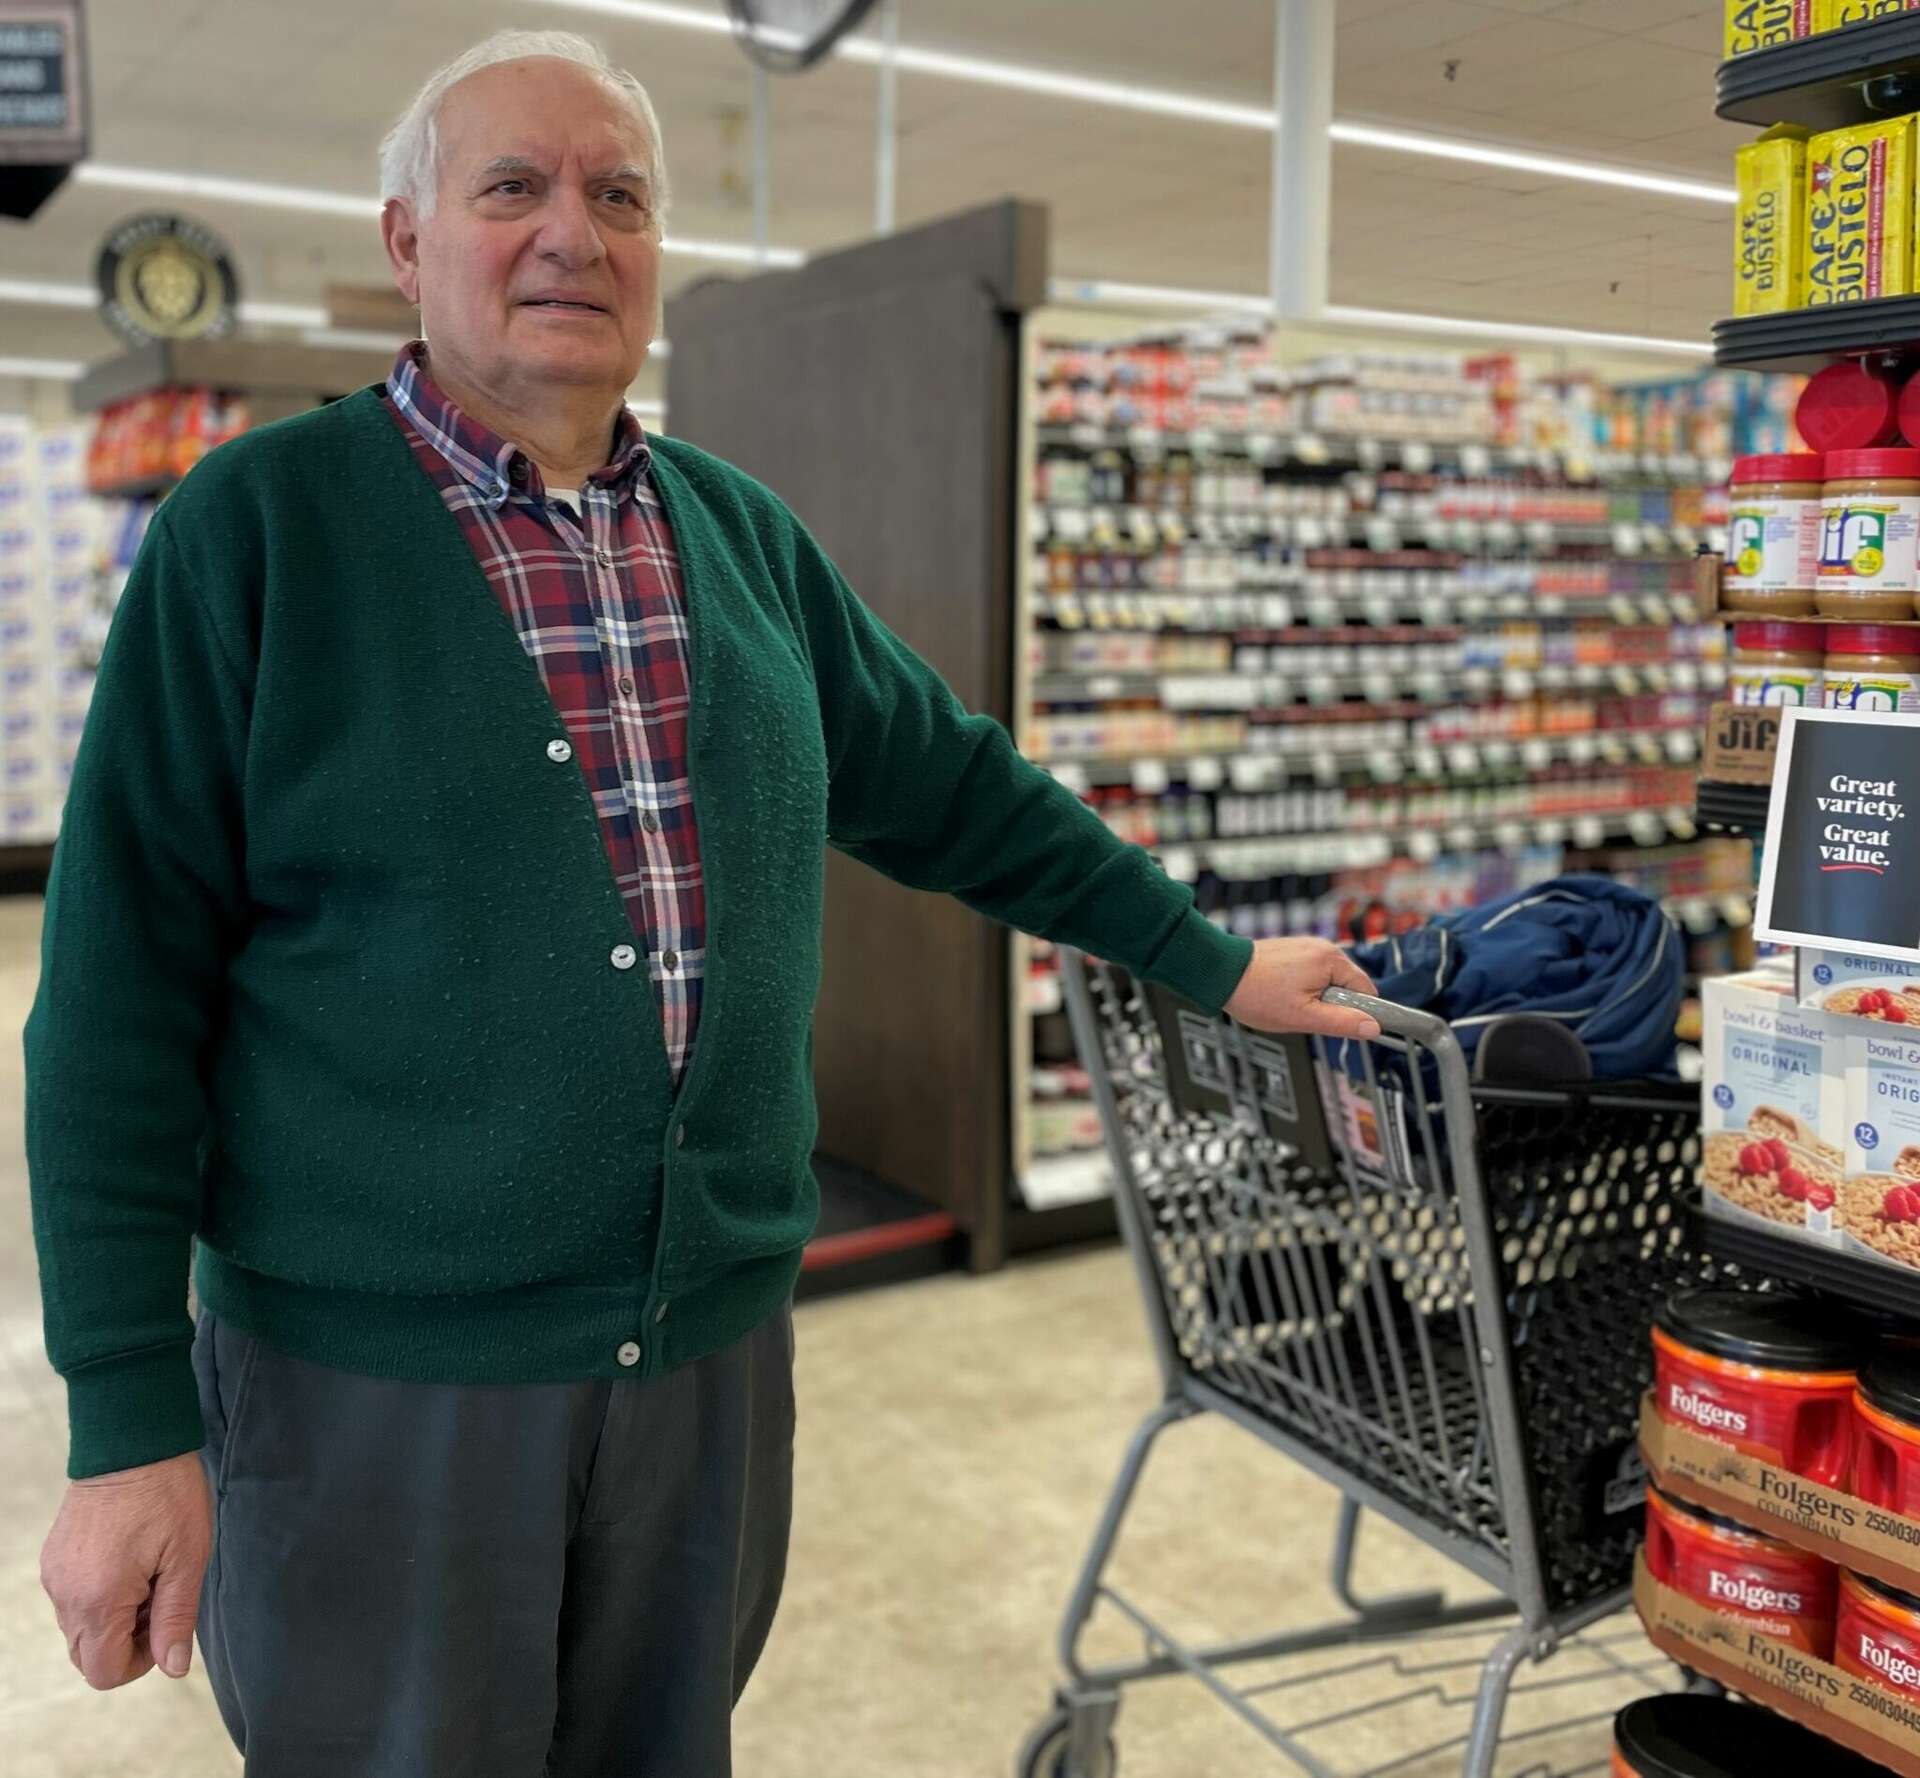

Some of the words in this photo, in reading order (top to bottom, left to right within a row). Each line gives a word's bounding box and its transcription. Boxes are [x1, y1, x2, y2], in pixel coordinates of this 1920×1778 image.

[1757, 190, 1775, 291] BUSTELO
[1837, 145, 1870, 304] BUSTELO
[1718, 719, 1777, 752] Jif
[1830, 775, 1897, 797] Great
[1816, 796, 1905, 821] variety.
[1823, 824, 1891, 847] Great
[1819, 843, 1891, 866] value.
[1844, 957, 1915, 977] ORIGINAL
[1723, 1007, 1756, 1027] bowl
[1775, 1019, 1826, 1042] basket
[1732, 1046, 1812, 1076] ORIGINAL
[1867, 1039, 1903, 1061] bowl
[1860, 1126, 1874, 1141] 12
[1670, 1384, 1747, 1432] Folgers
[1759, 1469, 1856, 1527] Folgers
[1757, 1498, 1842, 1542] COLOMBIAN
[1709, 1570, 1801, 1611] Folgers
[1747, 1632, 1840, 1697] Folgers
[1860, 1634, 1920, 1685] Folge
